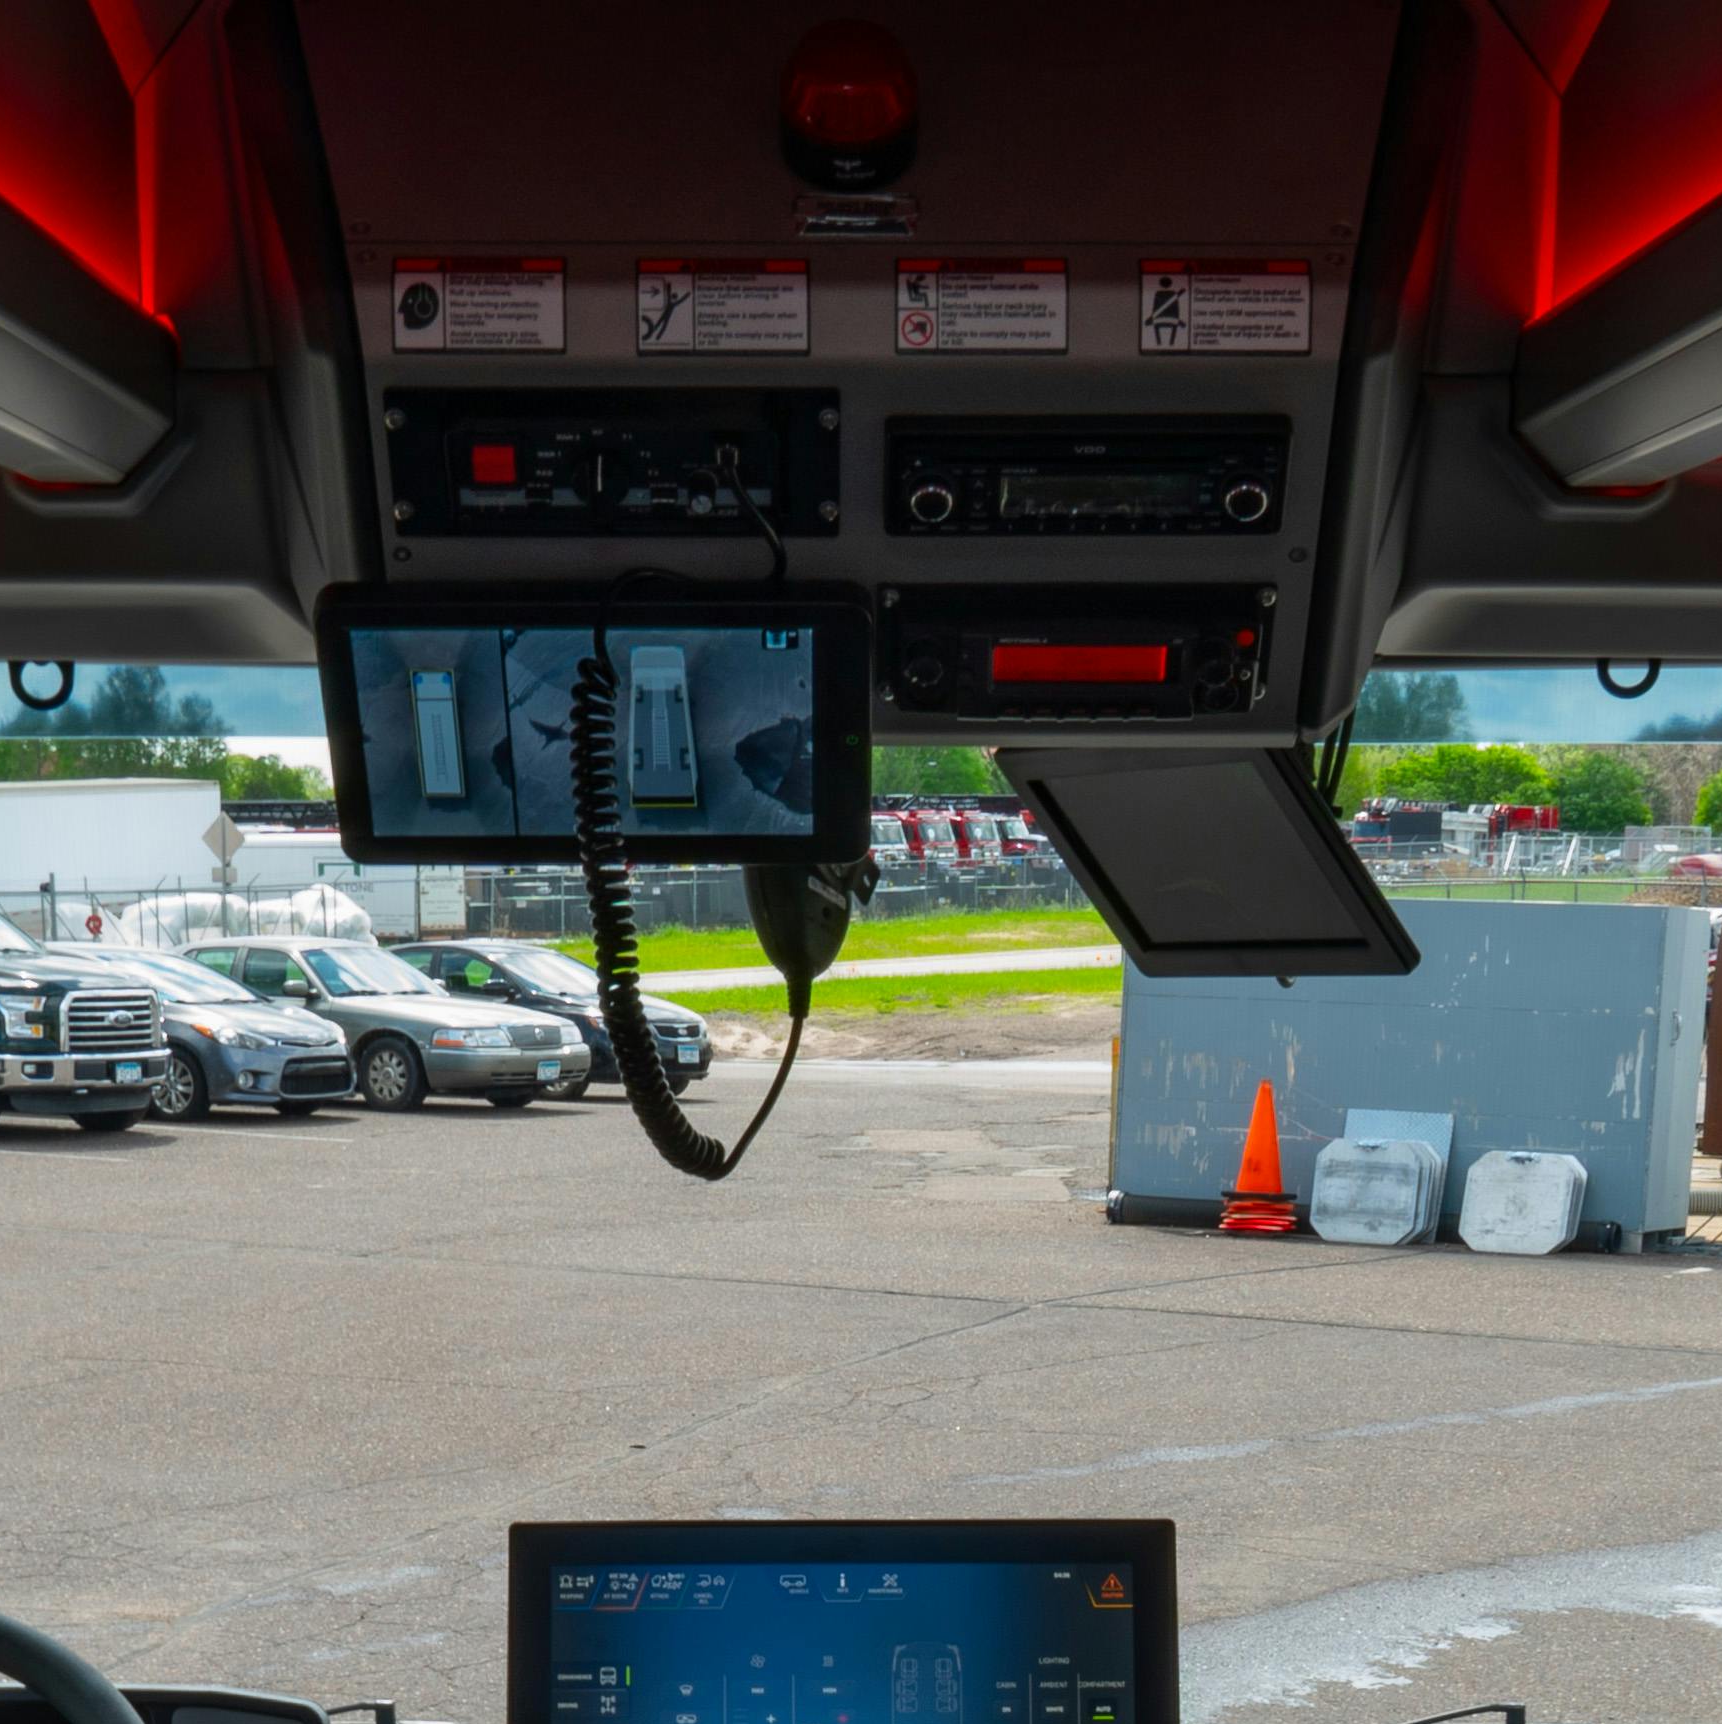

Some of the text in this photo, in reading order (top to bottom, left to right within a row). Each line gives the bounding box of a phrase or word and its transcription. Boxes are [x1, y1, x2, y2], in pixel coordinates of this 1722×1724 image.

[1073, 446, 1107, 456] VDO
[1038, 1657, 1070, 1666] LIGHTING
[1040, 1681, 1068, 1689] AMBIENT
[1078, 1681, 1125, 1689] COMPARTMENT
